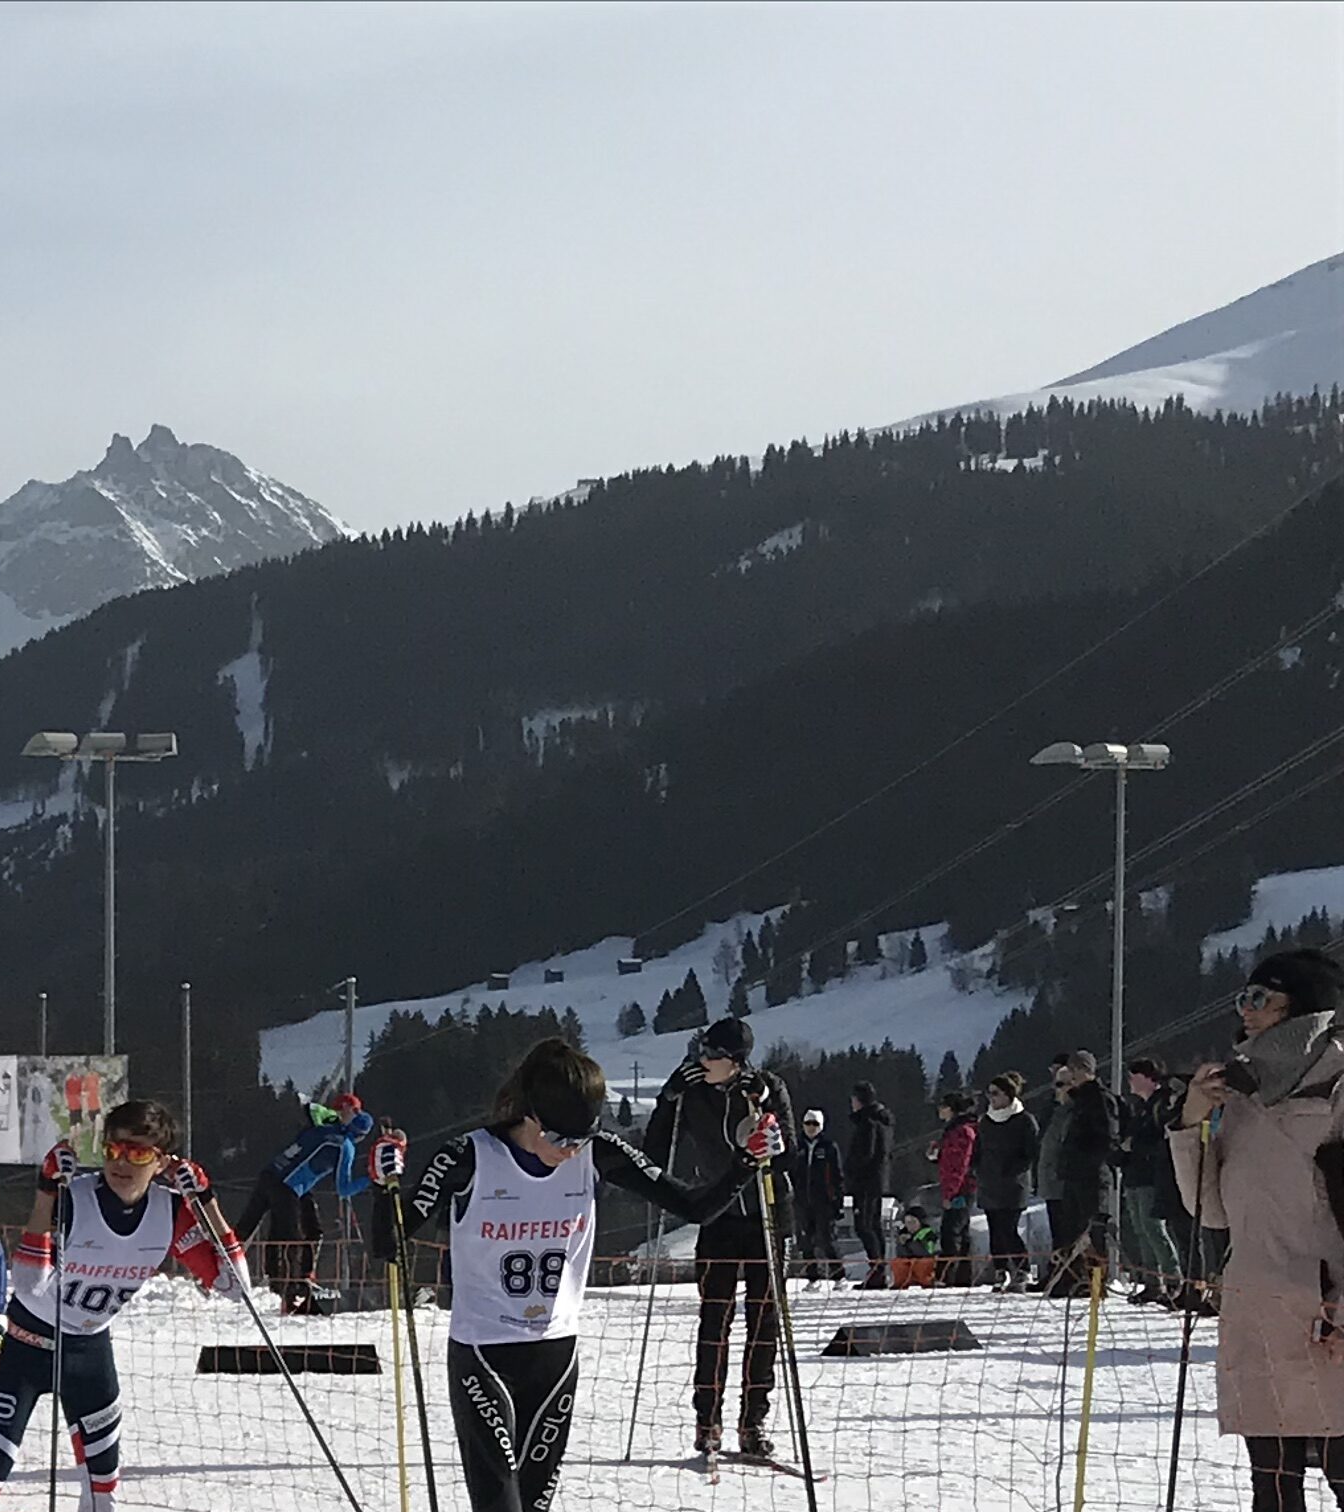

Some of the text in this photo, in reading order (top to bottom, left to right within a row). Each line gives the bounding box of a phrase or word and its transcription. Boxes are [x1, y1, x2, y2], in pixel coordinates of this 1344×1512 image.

[412, 1152, 458, 1218] ALPIQ
[500, 1249, 568, 1298] 88
[461, 1375, 517, 1471] swisscom
[530, 1393, 573, 1462] odlo
